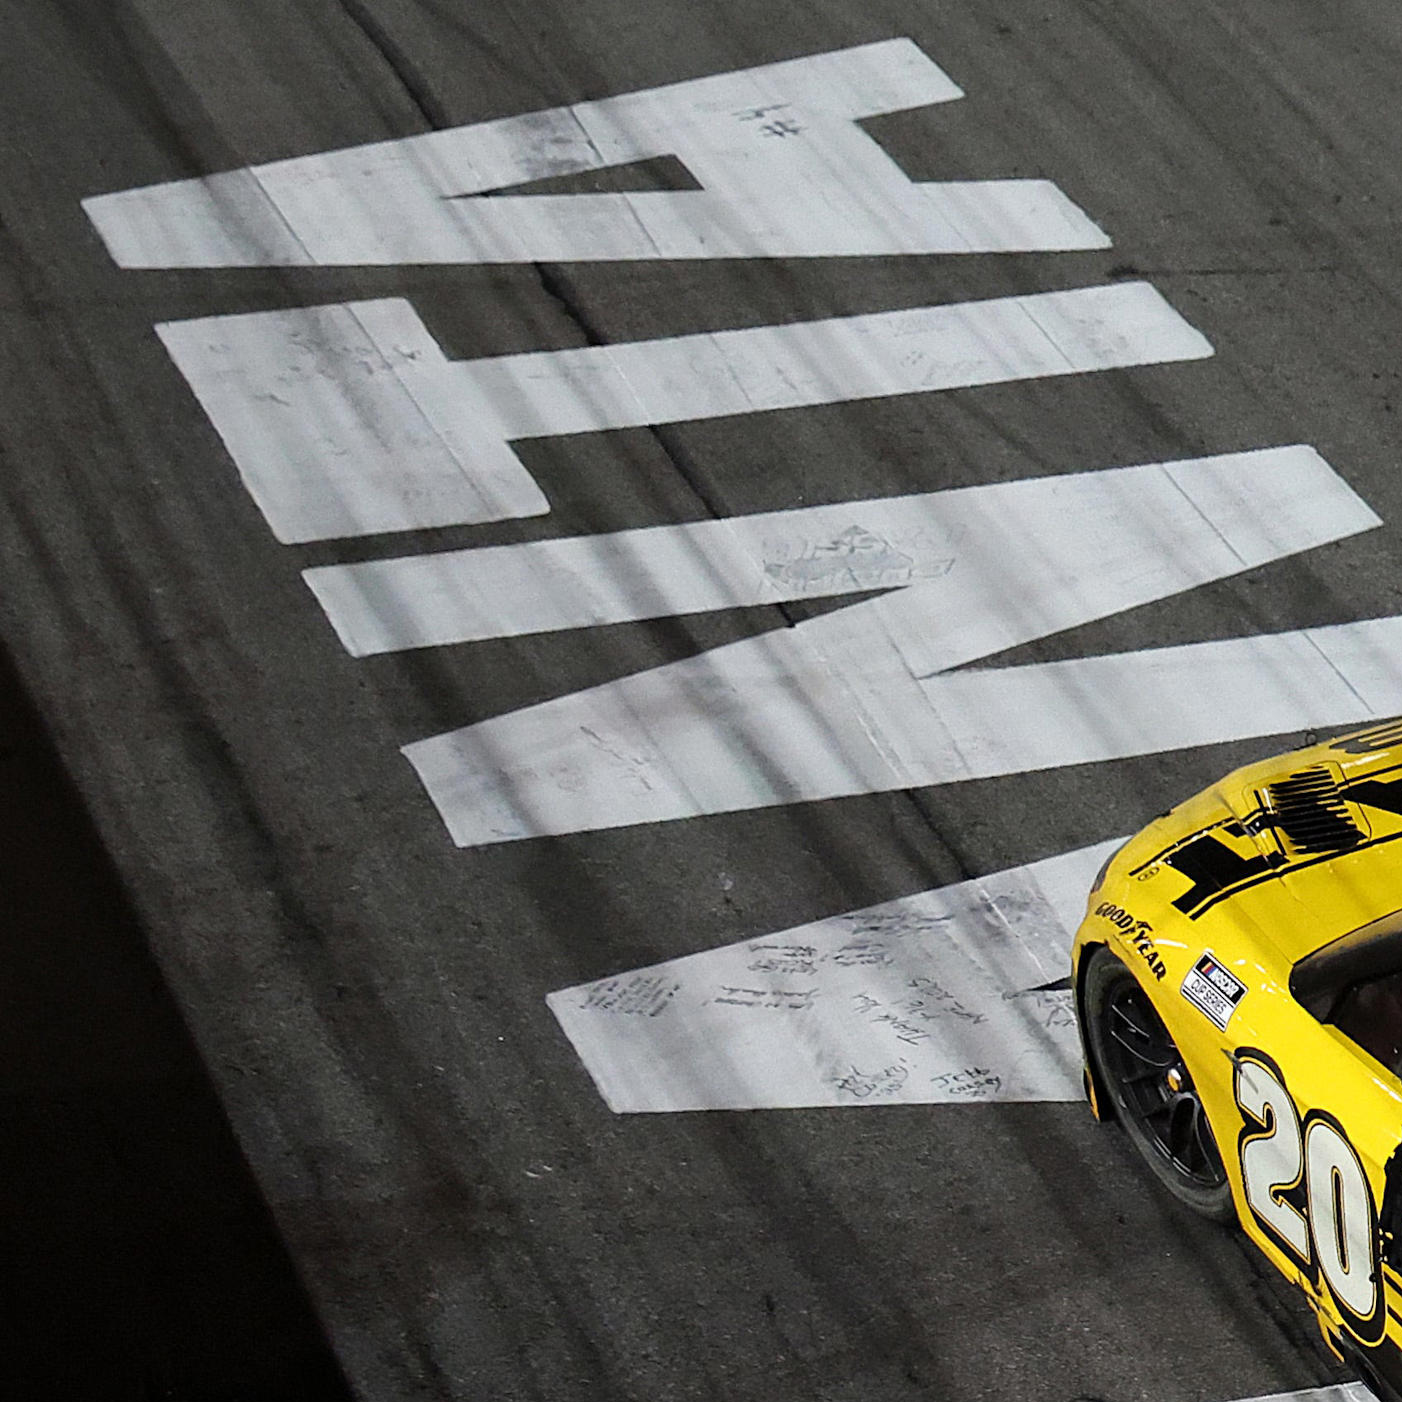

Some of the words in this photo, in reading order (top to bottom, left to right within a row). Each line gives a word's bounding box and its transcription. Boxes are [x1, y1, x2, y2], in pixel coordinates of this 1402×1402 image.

[1095, 901, 1167, 983] GOODYEAR
[1190, 978, 1204, 996] CUP
[1202, 989, 1228, 1015] SERIES
[1237, 1055, 1383, 1325] 20
